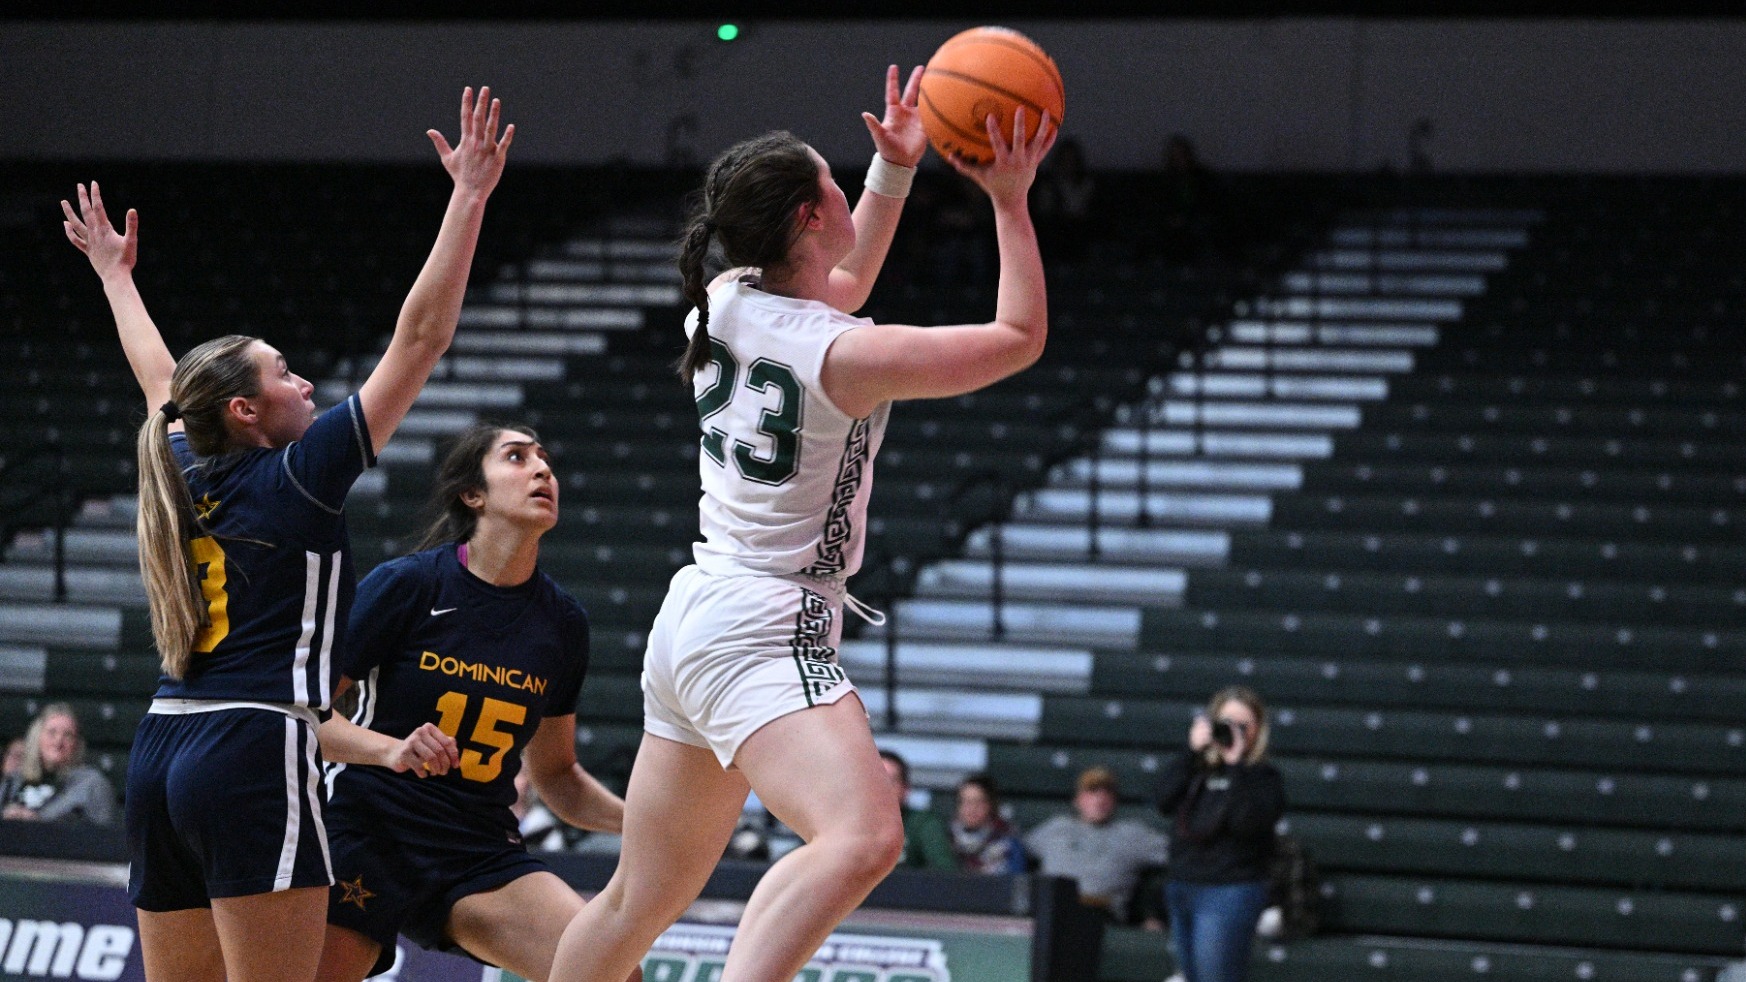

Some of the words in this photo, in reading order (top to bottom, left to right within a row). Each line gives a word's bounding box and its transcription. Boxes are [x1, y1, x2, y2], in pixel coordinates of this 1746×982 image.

[696, 336, 805, 487] 23
[418, 650, 548, 696] DOMINICAN
[435, 690, 527, 783] 15
[0, 917, 135, 981] me
